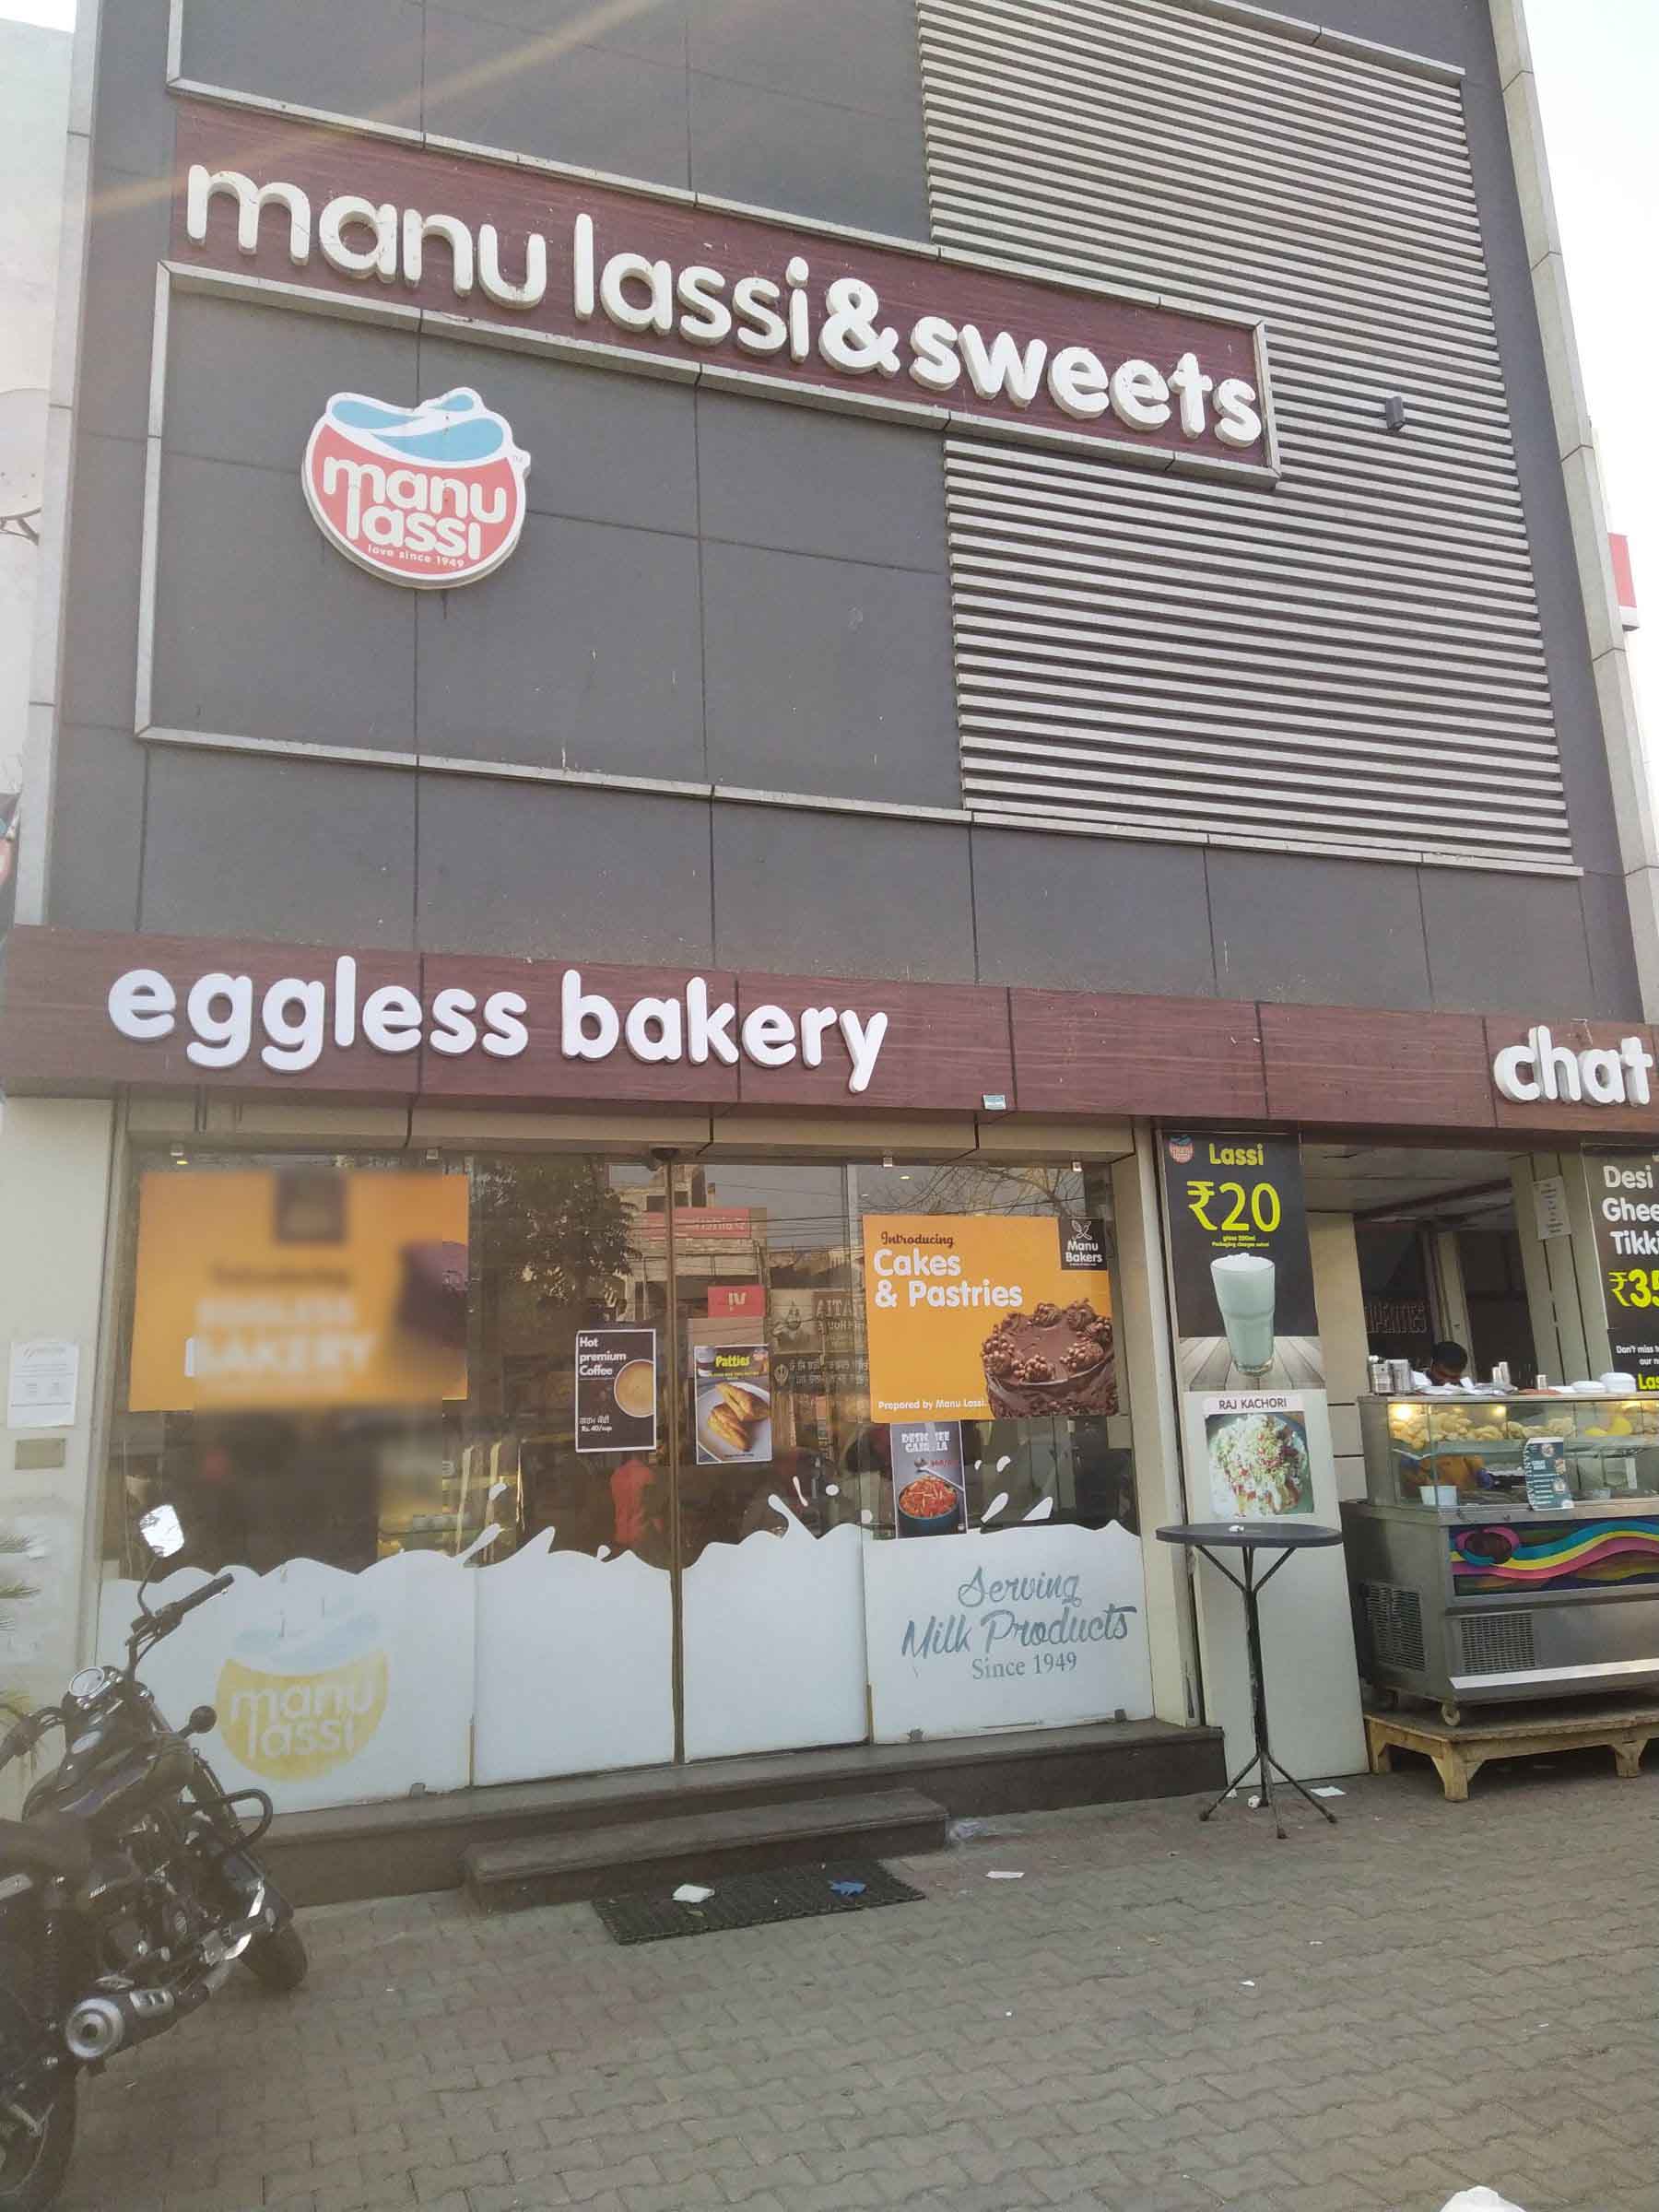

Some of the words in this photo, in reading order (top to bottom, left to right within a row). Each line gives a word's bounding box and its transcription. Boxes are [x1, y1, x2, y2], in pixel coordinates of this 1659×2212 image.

[187, 165, 546, 309] manu
[573, 213, 810, 363] lassi
[818, 277, 900, 379] &
[909, 316, 1262, 448] sweets
[324, 456, 506, 524] manu
[347, 487, 481, 560] lassi
[399, 550, 431, 563] since
[437, 556, 465, 568] 1949
[108, 955, 529, 1074] eggless
[561, 970, 888, 1094] bakery
[1493, 1025, 1654, 1106] chat
[1208, 1143, 1264, 1165] Lassi
[1603, 1164, 1653, 1189] Desi
[1186, 1181, 1281, 1231] ₹20
[1602, 1197, 1659, 1222] Ghee
[880, 1231, 954, 1249] Introducing
[1067, 1240, 1099, 1252] Manu
[874, 1247, 961, 1277] Cakes
[1065, 1252, 1103, 1263] Bakers
[875, 1279, 898, 1308] &
[908, 1278, 1023, 1308] Pastries
[579, 1336, 599, 1347] Hot
[1616, 1345, 1636, 1354] Don't
[1637, 1344, 1653, 1354] miss
[579, 1350, 627, 1364] premium
[579, 1365, 613, 1376] Coffee
[877, 1400, 921, 1411] Prepared
[923, 1400, 933, 1410] by
[935, 1399, 960, 1408] Manu
[1218, 1400, 1237, 1410] RAJ
[1241, 1397, 1288, 1409] KACHORI
[959, 1566, 1083, 1607] Serving
[900, 1615, 972, 1659] Milk
[981, 1604, 1137, 1653] Products
[971, 1658, 1026, 1680] Since
[1033, 1652, 1077, 1675] 1949
[230, 1679, 376, 1722] manu
